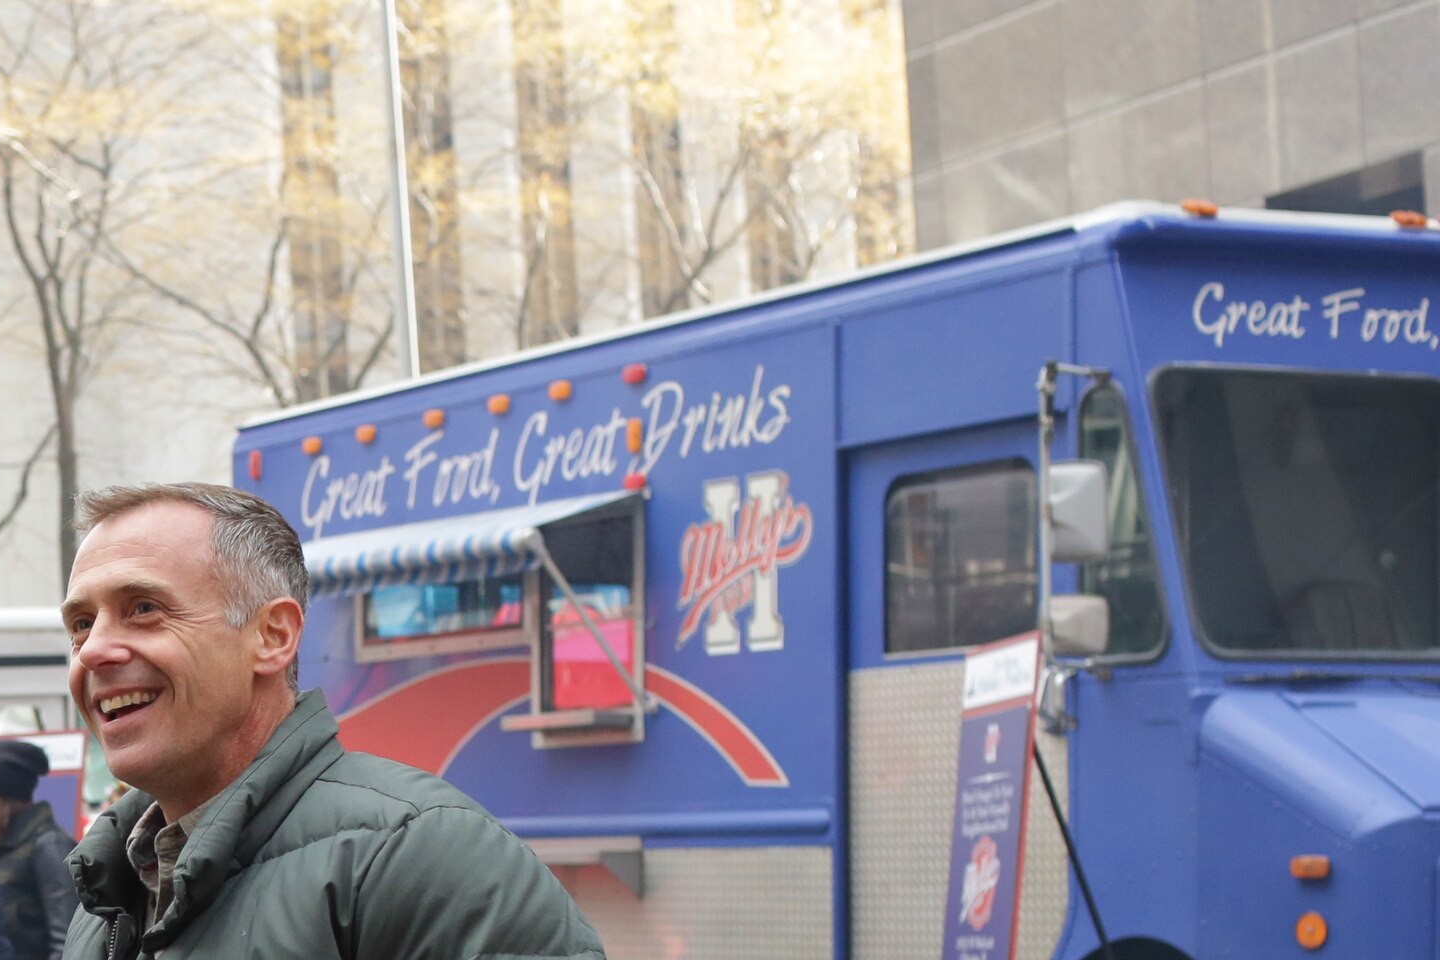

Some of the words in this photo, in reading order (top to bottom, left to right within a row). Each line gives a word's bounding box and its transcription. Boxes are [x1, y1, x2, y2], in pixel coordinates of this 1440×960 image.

[1191, 281, 1311, 348] Great
[1321, 287, 1439, 350] Food,
[300, 455, 395, 541] Great
[403, 430, 500, 507] Food,
[513, 411, 627, 505] Great
[629, 364, 792, 475] Drinks
